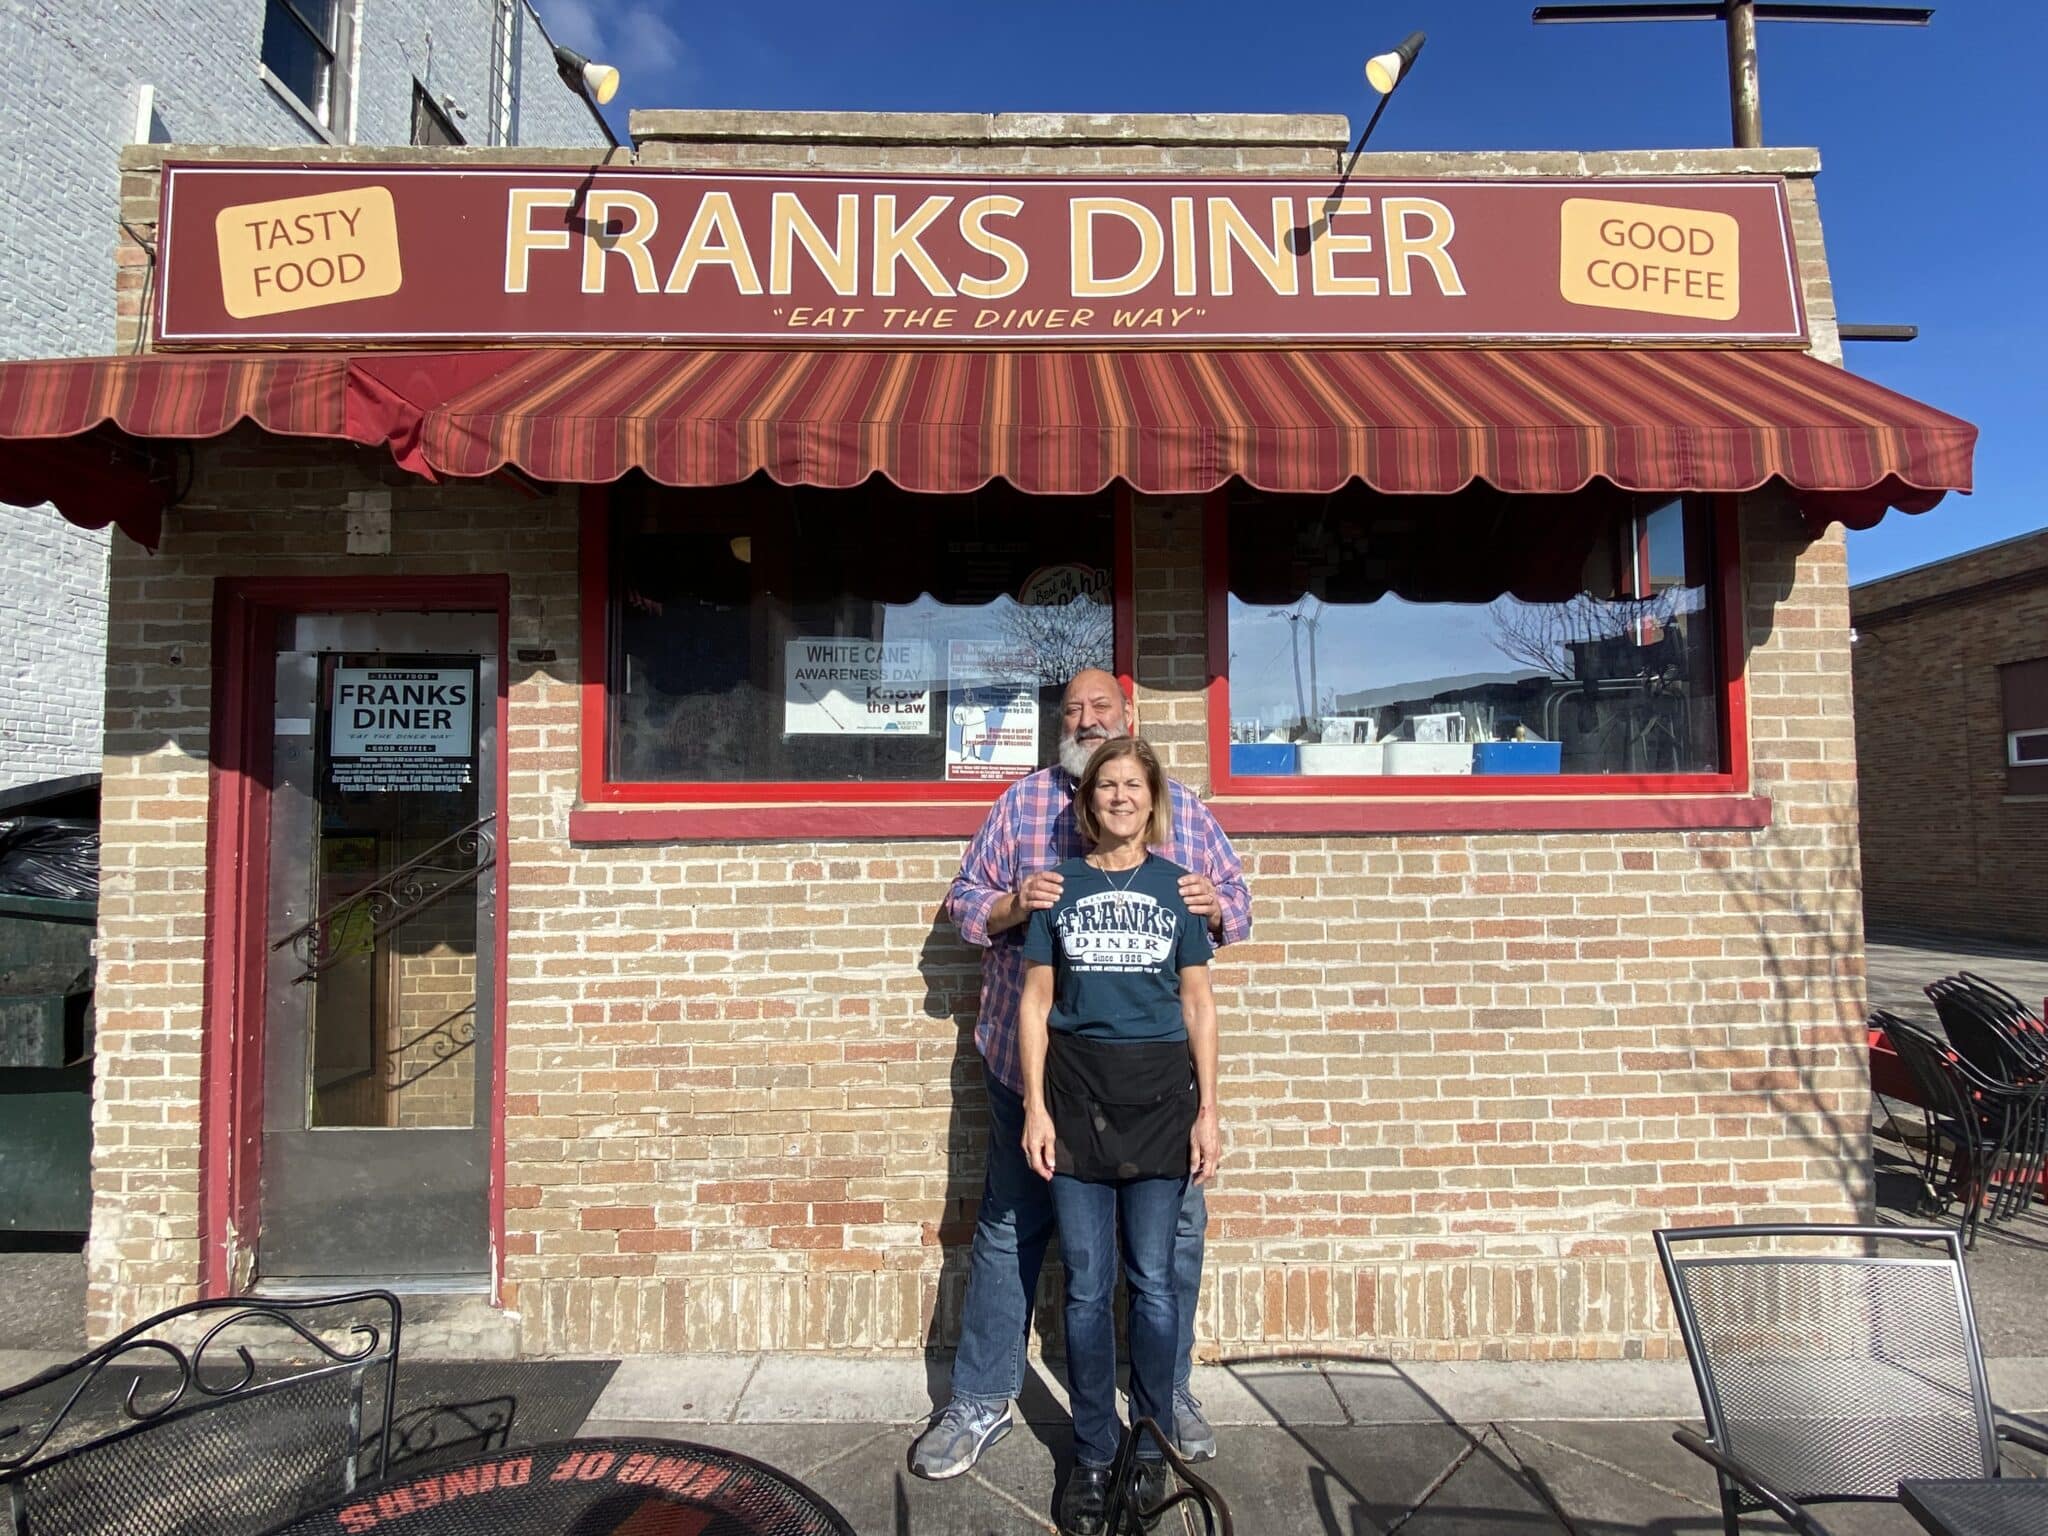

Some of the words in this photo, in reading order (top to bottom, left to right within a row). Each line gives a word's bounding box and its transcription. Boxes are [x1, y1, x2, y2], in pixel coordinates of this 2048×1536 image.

[245, 207, 362, 252] TASTY
[1599, 218, 1715, 256] GOOD
[504, 188, 1029, 300] FRANKS
[1069, 196, 1467, 298] DINER
[252, 252, 367, 297] FOOD
[1586, 259, 1726, 301] COFFEE
[883, 307, 957, 328] THE
[974, 308, 1095, 329] DINER
[806, 645, 860, 663] WHITE
[864, 646, 911, 664] CANE
[795, 668, 888, 680] AWARENESS
[893, 668, 921, 680] DAY
[340, 685, 466, 705] FRANKS
[866, 686, 926, 699] Know
[867, 701, 890, 713] the
[895, 701, 926, 714] Law
[353, 709, 452, 729] DINER
[1062, 900, 1174, 940] FRANKS
[1075, 938, 1159, 951] DINER
[1093, 953, 1113, 961] Since
[551, 1451, 615, 1481] OF
[338, 1457, 533, 1533] DINERS
